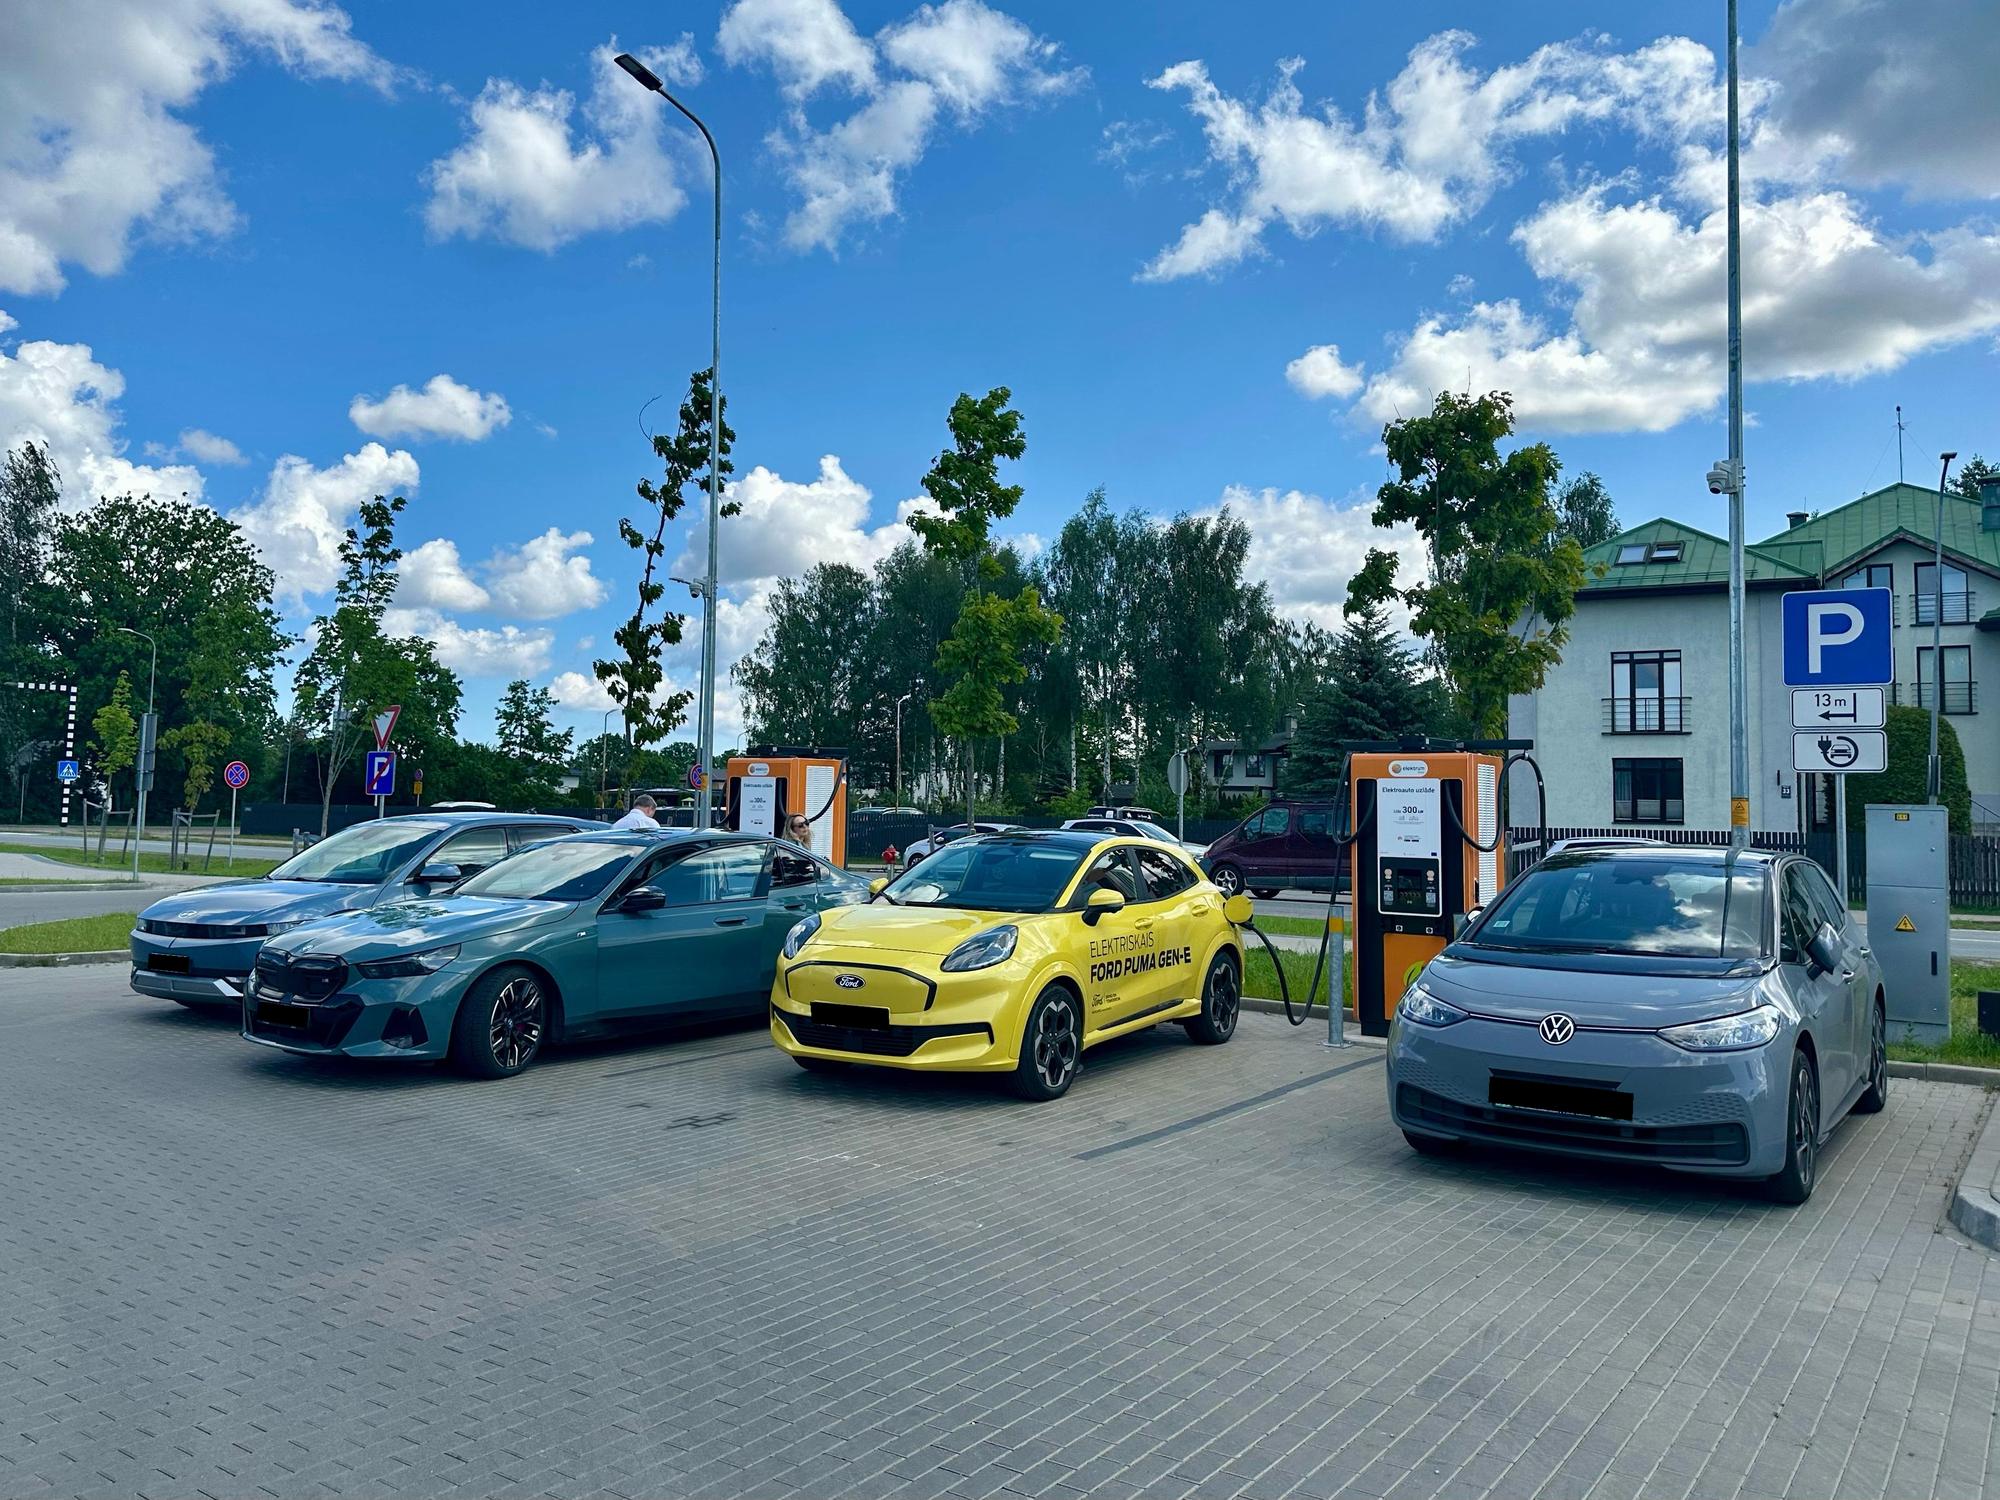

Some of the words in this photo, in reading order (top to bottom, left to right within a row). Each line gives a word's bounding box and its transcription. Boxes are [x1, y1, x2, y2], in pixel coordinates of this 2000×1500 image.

[1808, 602, 1865, 674] P
[1814, 693, 1831, 707] 13
[1834, 697, 1847, 707] m
[373, 757, 390, 790] P
[1402, 806, 1418, 814] 300
[1090, 931, 1155, 958] ELEKTRISKAIS
[1090, 959, 1122, 984] FORD
[1124, 952, 1156, 976] PUMA
[1158, 946, 1191, 969] GEN-E
[1539, 1012, 1575, 1045] VW
